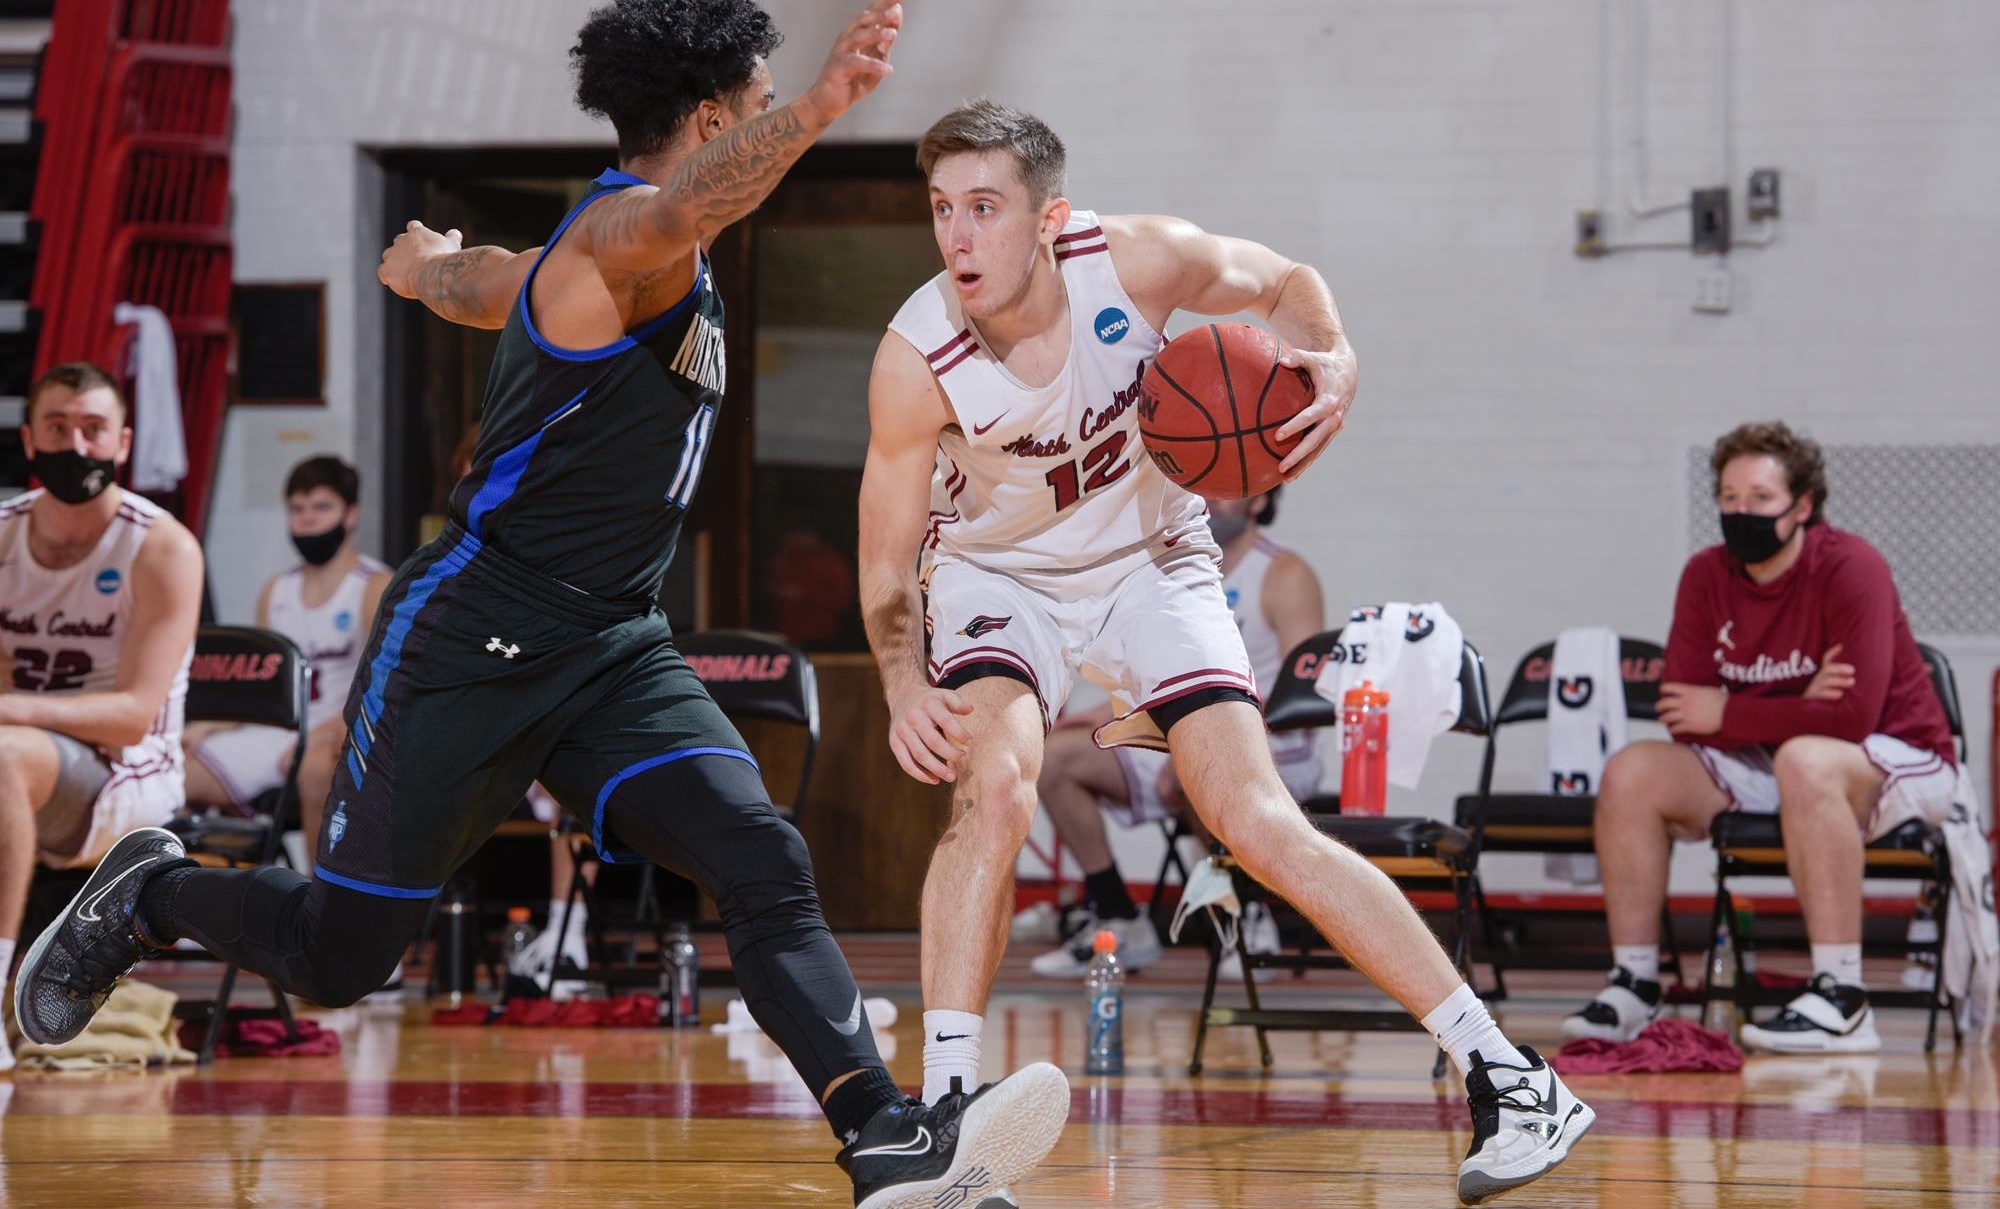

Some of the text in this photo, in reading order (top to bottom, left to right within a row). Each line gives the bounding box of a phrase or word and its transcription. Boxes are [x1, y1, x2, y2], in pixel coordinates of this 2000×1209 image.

[1100, 318, 1129, 340] NCAA
[1001, 432, 1072, 458] North
[1079, 359, 1146, 442] Central
[664, 403, 713, 511] 11
[1045, 430, 1131, 513] 12
[47, 610, 115, 638] Central
[12, 646, 93, 692] 22
[1097, 997, 1118, 1021] G
